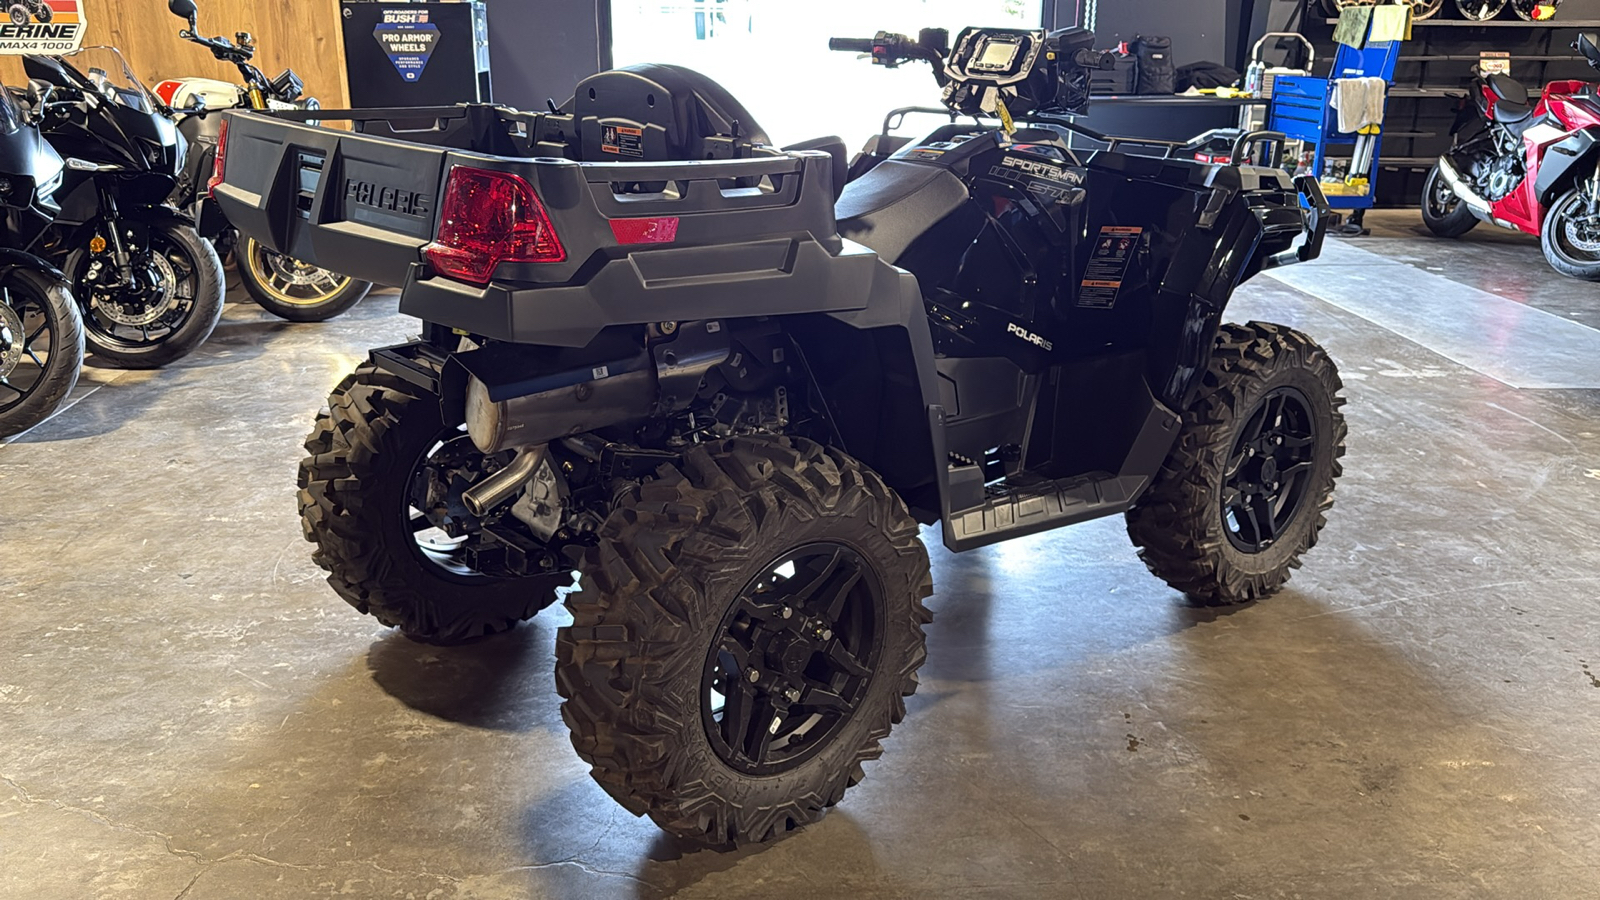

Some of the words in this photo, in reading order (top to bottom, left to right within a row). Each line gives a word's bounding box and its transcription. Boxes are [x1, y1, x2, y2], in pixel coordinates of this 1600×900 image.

[384, 14, 416, 23] BUSH
[382, 34, 400, 42] PRO
[402, 34, 432, 42] ARMOR
[41, 42, 74, 50] 1000
[390, 43, 426, 52] WHEELS
[1001, 155, 1084, 185] SPORTSMAN
[342, 178, 432, 219] POLARIS
[1007, 322, 1053, 351] POLARIS
